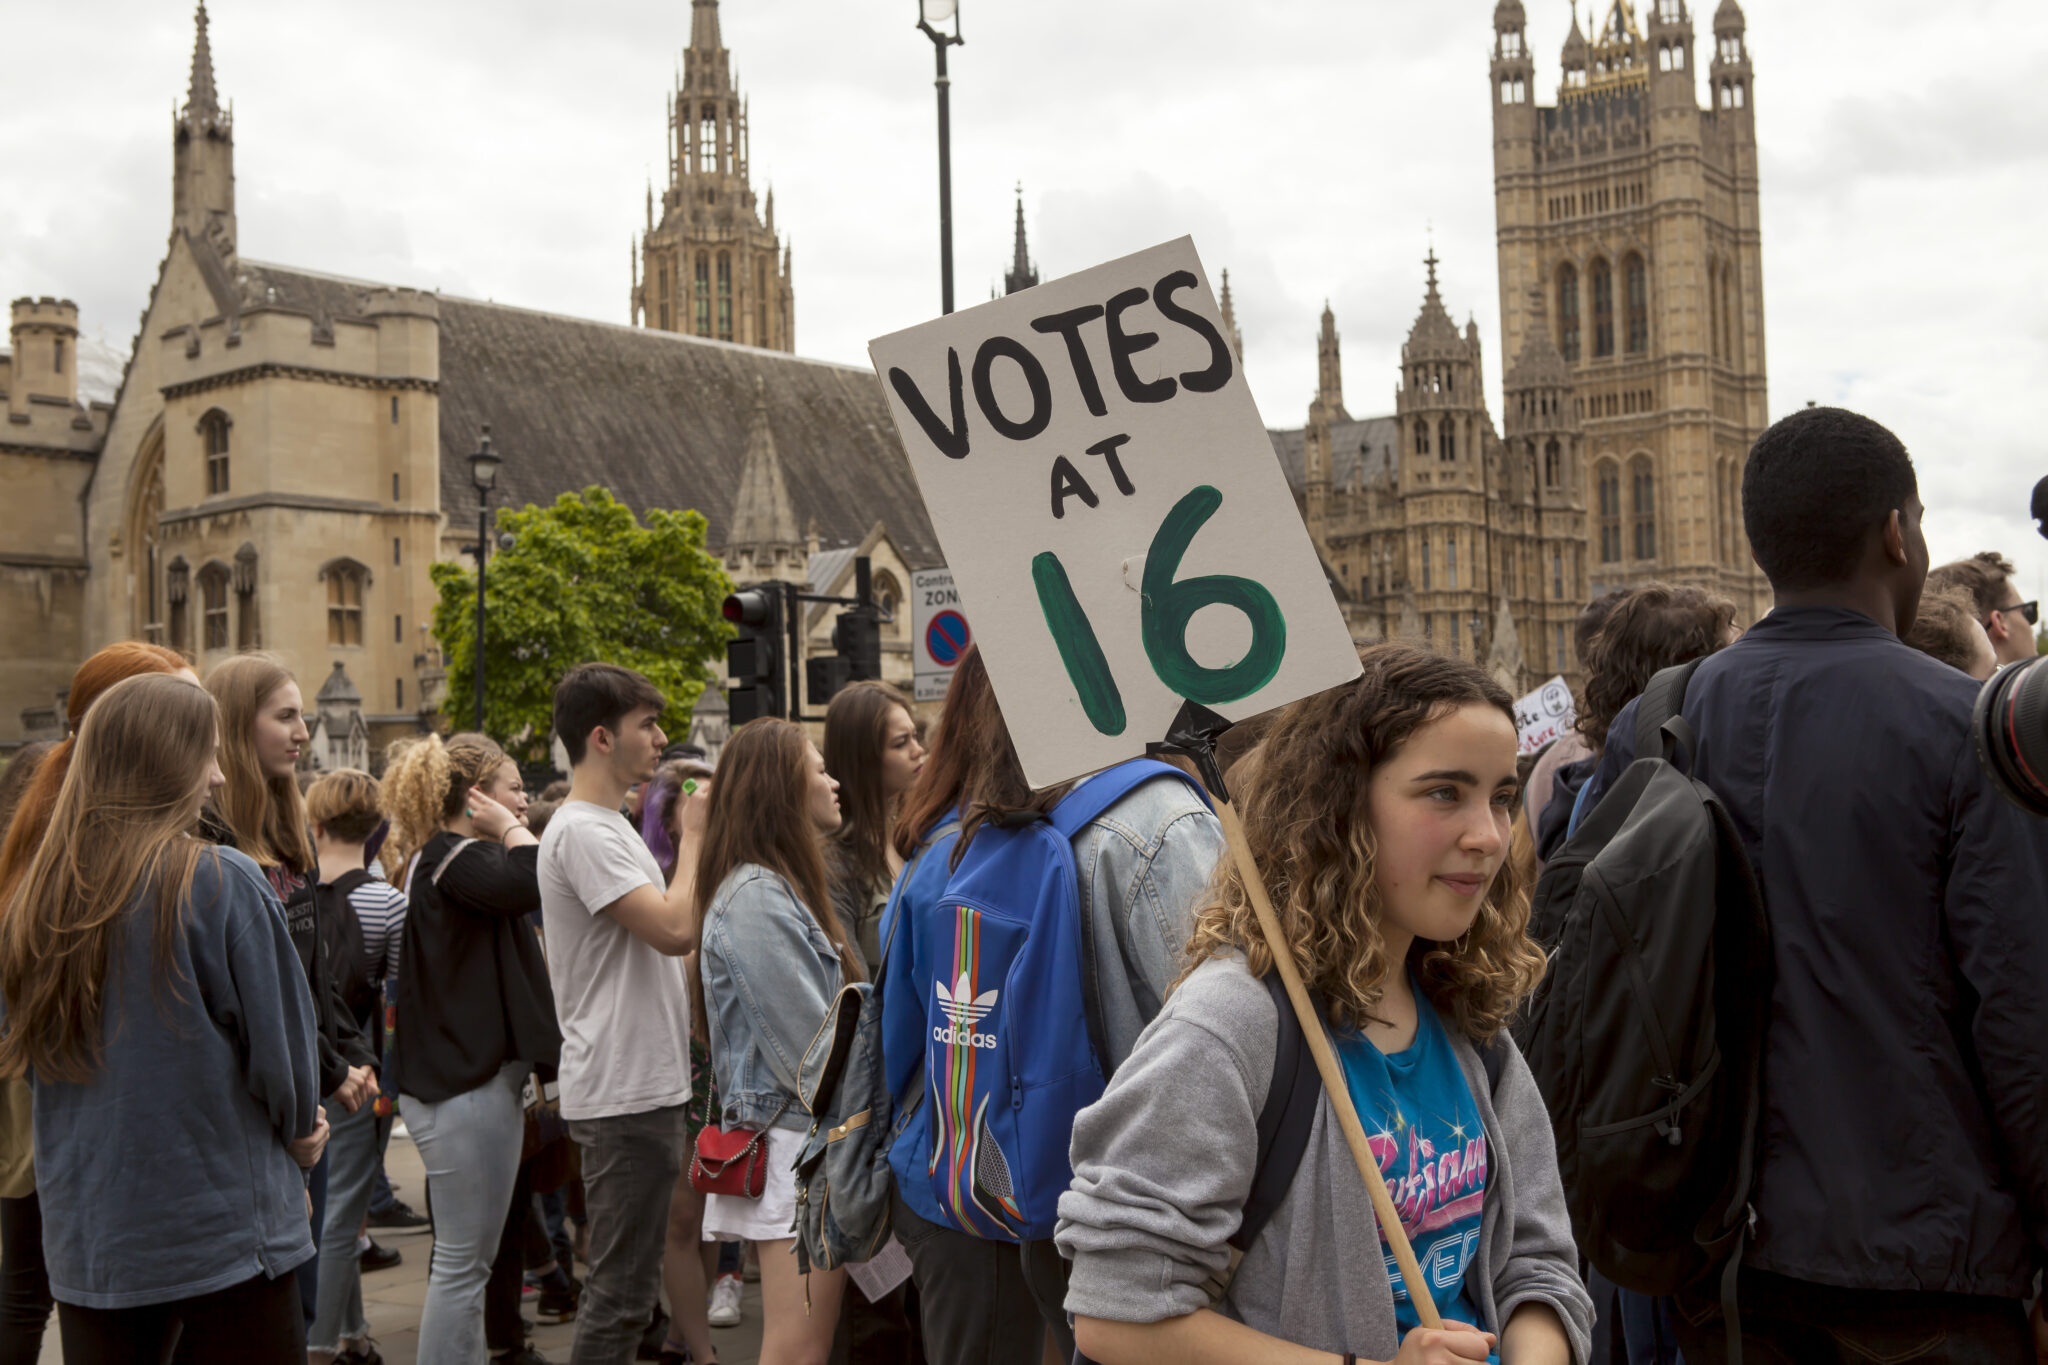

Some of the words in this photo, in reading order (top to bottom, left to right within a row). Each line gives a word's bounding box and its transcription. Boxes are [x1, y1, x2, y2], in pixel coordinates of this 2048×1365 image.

[888, 270, 1233, 459] VOTES
[1050, 433, 1136, 519] AT
[925, 588, 961, 606] ZON
[1031, 484, 1287, 736] 16
[1516, 711, 1539, 729] ote
[933, 1025, 997, 1049] adidas
